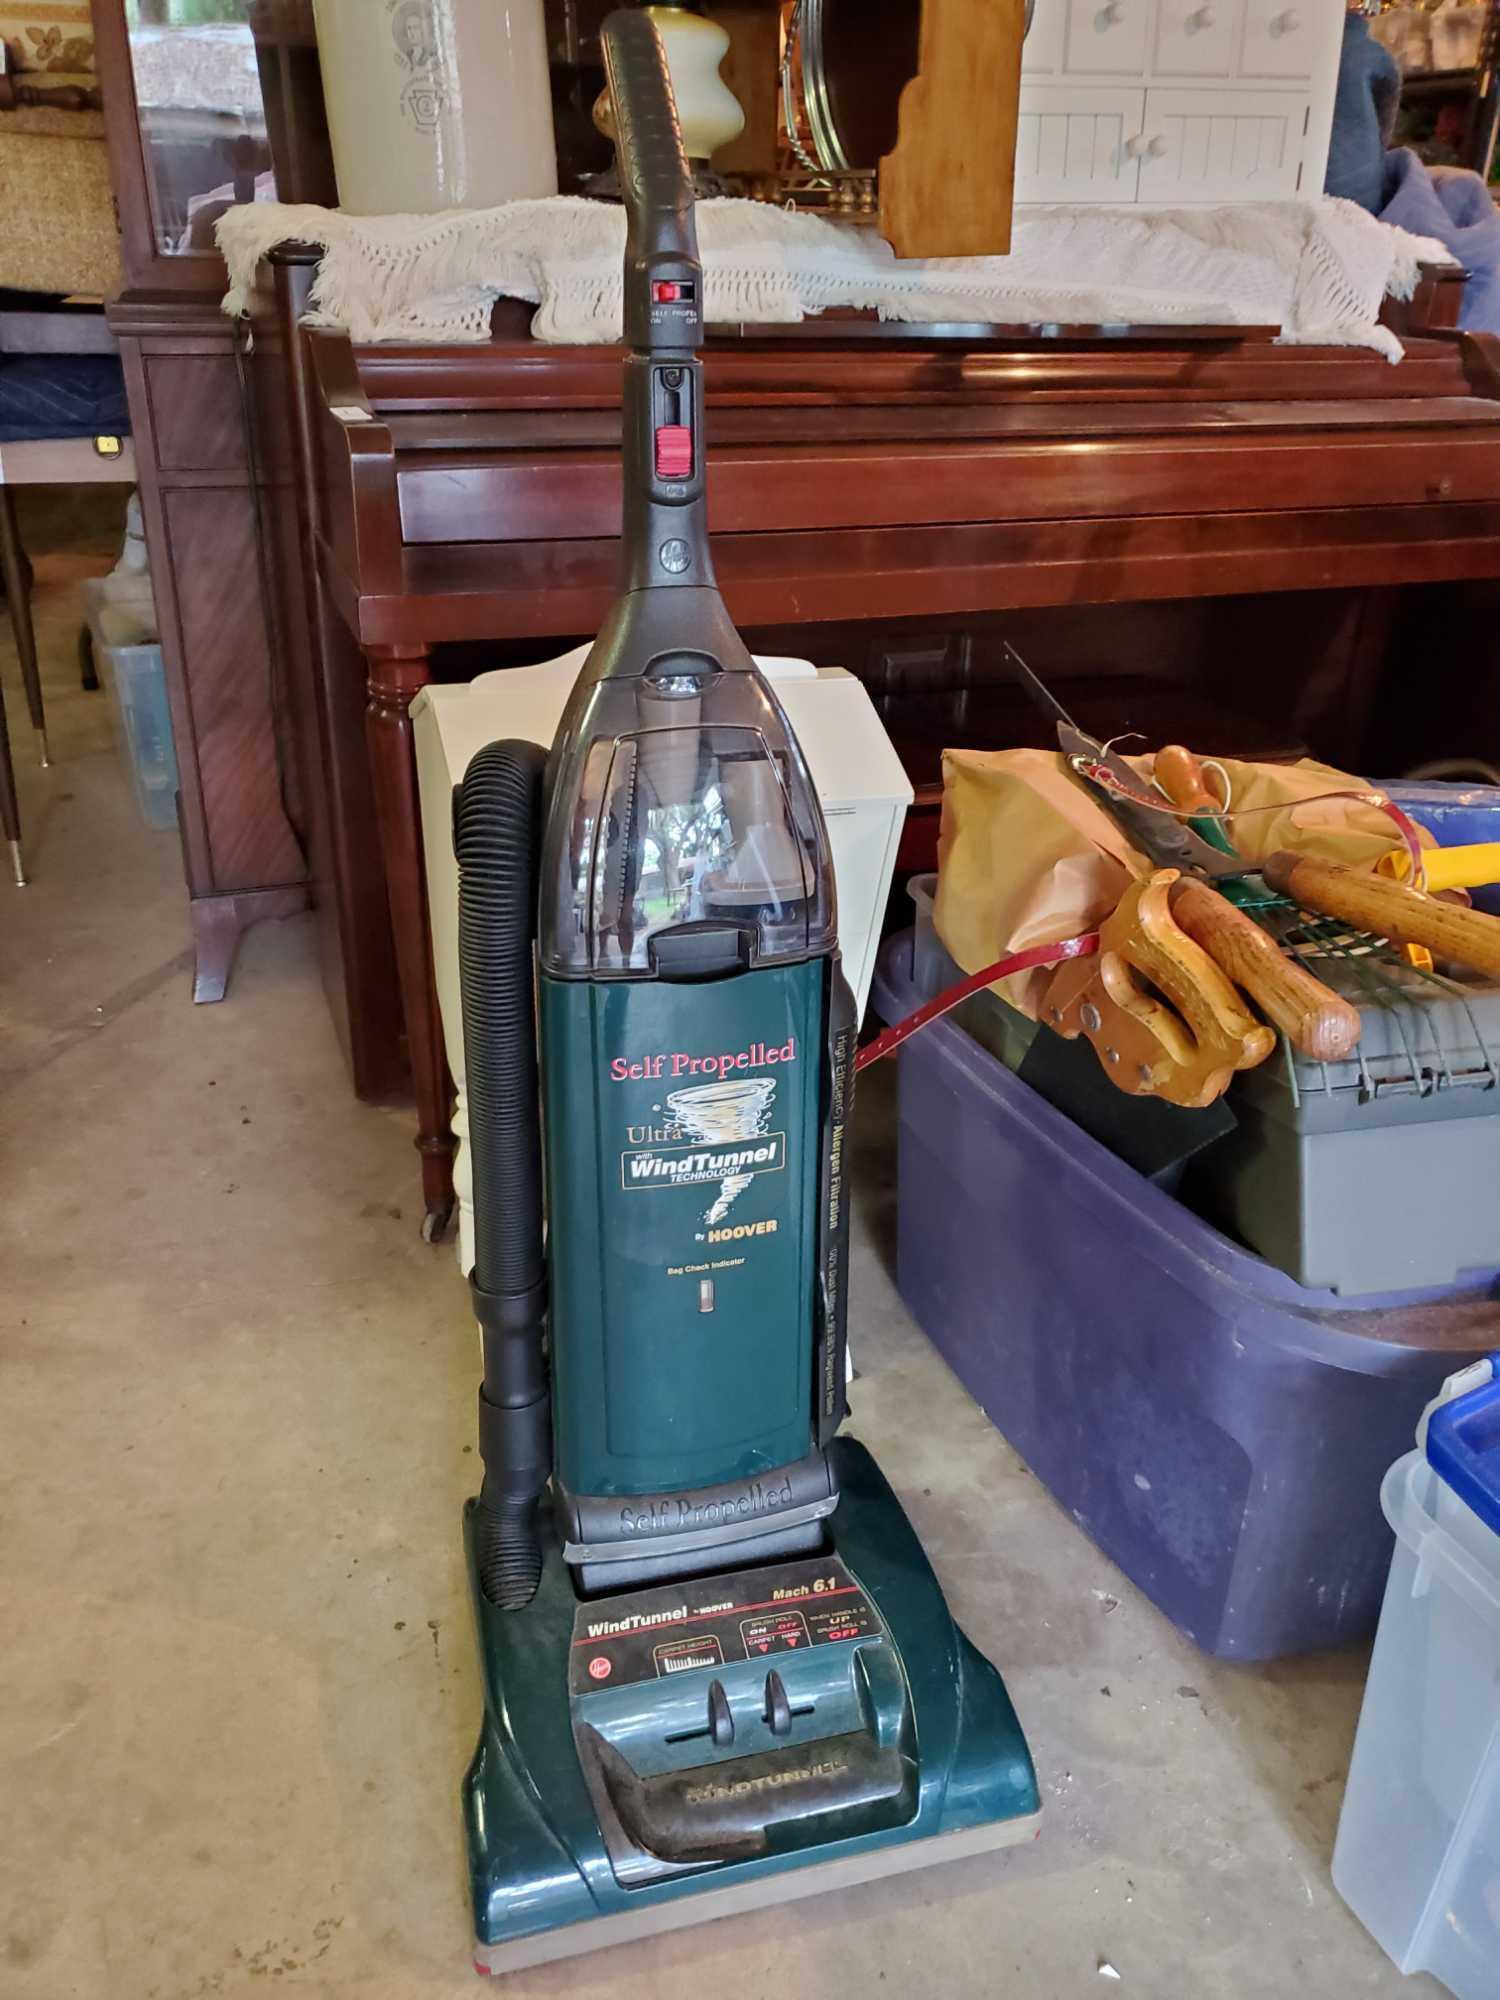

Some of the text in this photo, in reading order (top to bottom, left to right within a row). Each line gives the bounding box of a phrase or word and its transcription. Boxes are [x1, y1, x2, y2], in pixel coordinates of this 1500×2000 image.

[610, 1037, 796, 1081] Self Propelled
[834, 1034, 848, 1063] High
[626, 1125, 684, 1144] Ultra
[630, 1141, 777, 1179] WindTunnel
[635, 1152, 653, 1161] with
[671, 1166, 742, 1183] TECHNOLOGY
[829, 1125, 844, 1230] Allergen Filtration
[708, 1219, 778, 1244] HOOVER
[667, 1257, 746, 1276] Bag Check Indicator
[619, 1475, 793, 1532] Self Propelled
[773, 1576, 836, 1600] Mach 6.1
[587, 1605, 688, 1637] WindTunnel
[749, 1621, 798, 1636] ON OFF
[828, 1615, 851, 1626] UP
[827, 1627, 860, 1640] OFF
